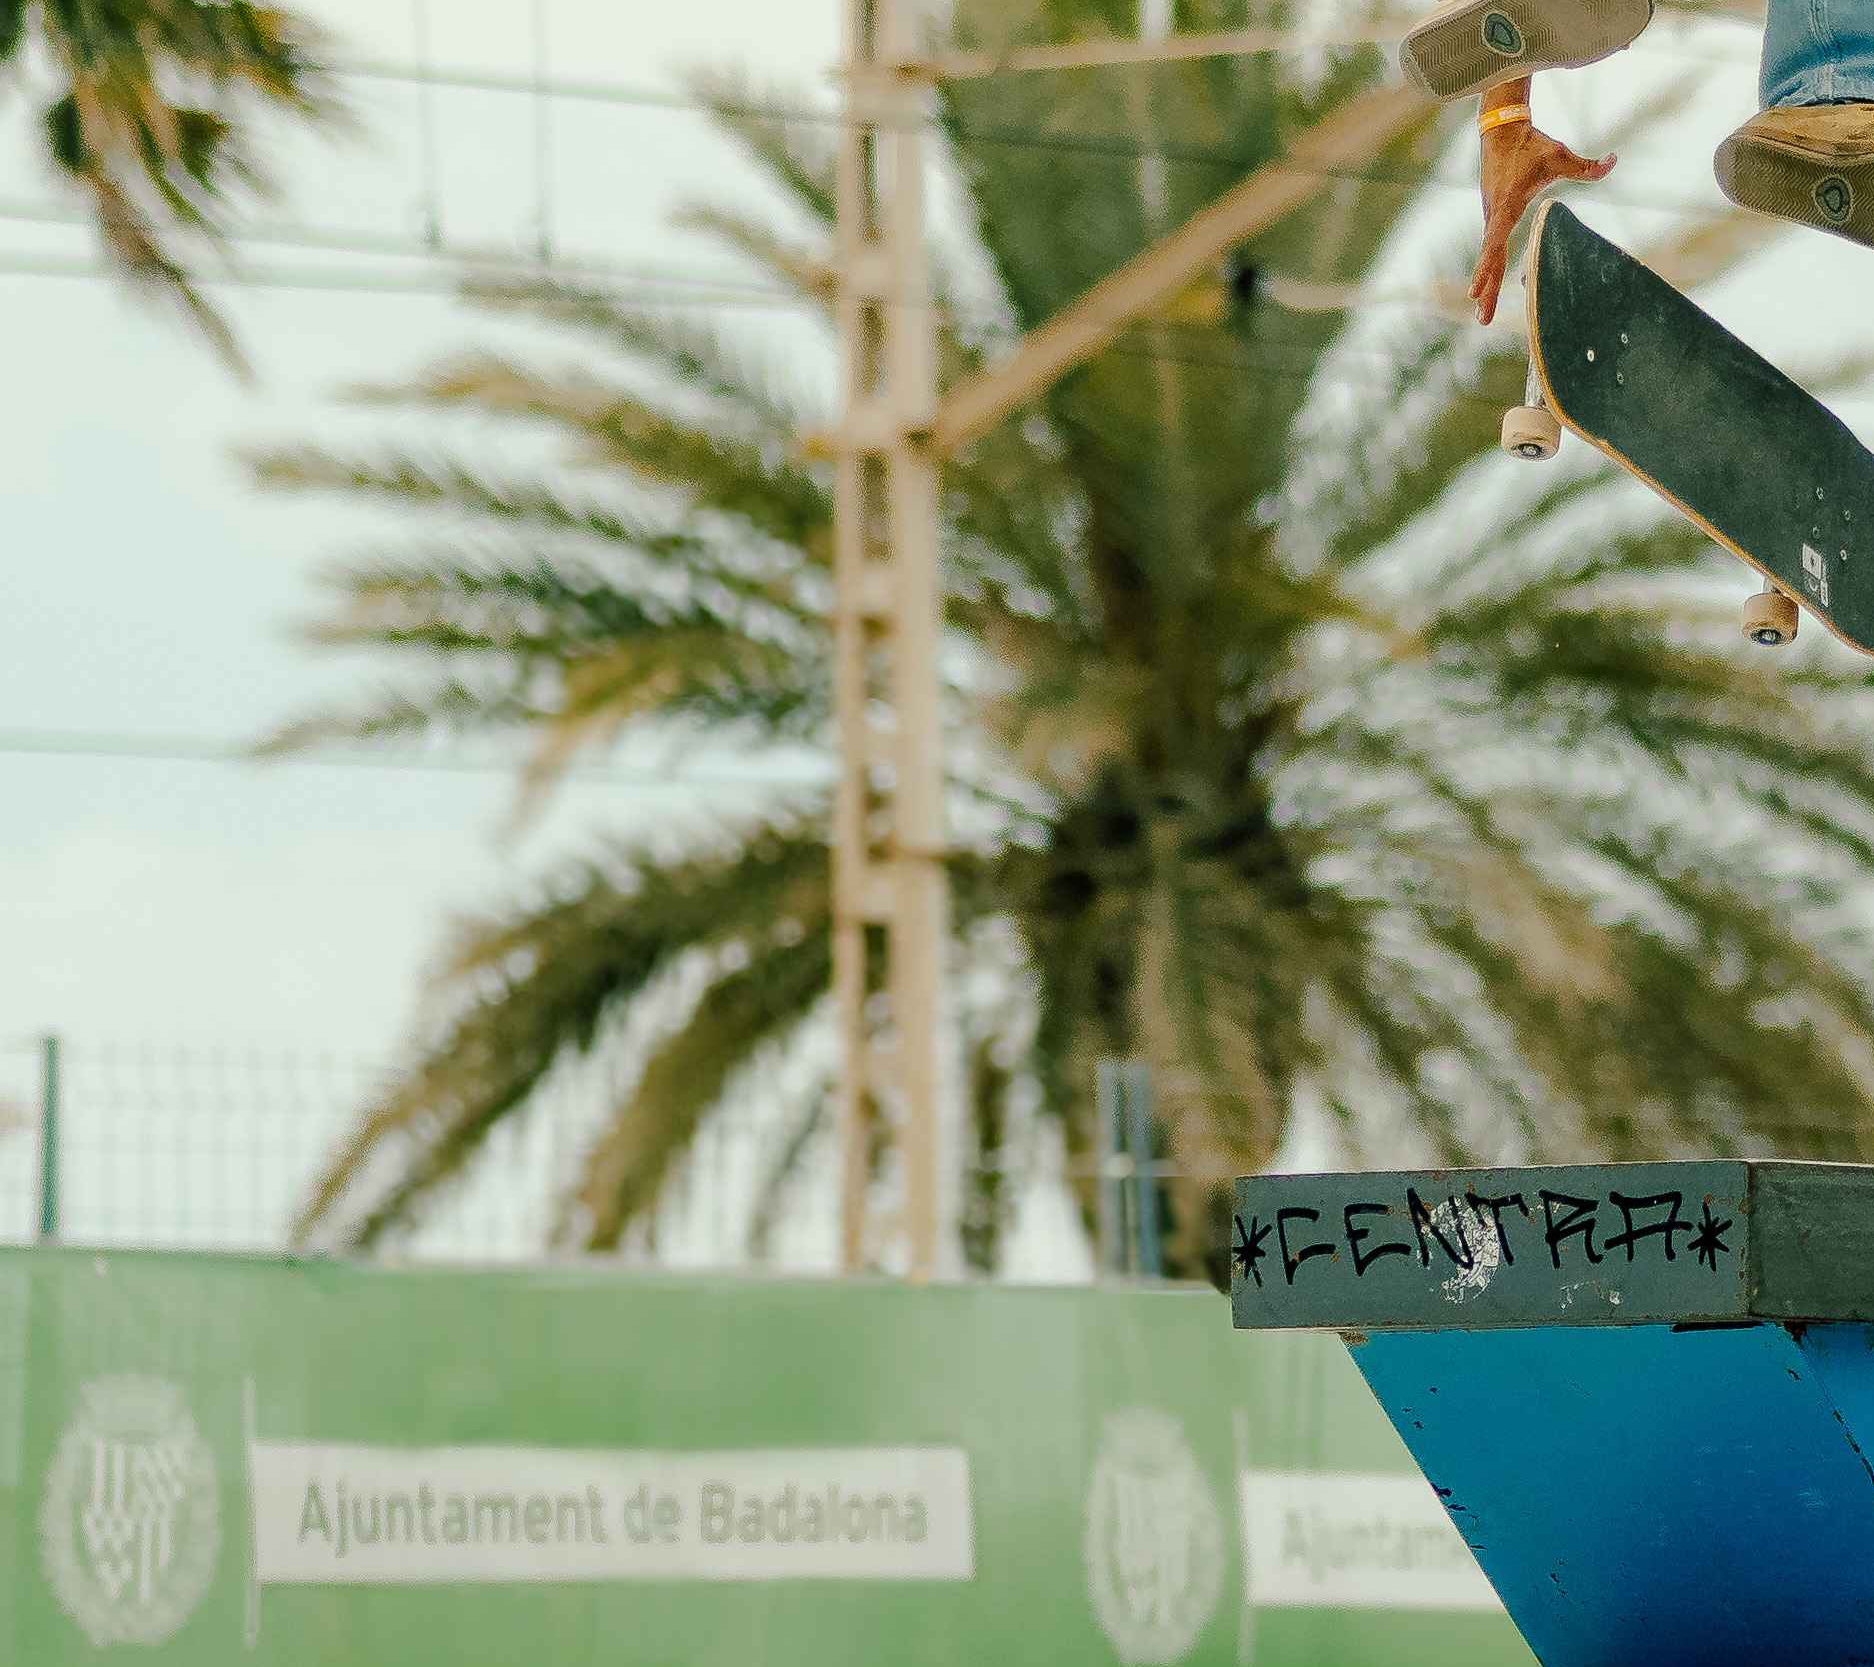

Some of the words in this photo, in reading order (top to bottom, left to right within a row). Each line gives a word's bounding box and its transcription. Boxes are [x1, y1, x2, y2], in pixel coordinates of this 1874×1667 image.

[301, 1478, 608, 1558] Ajuntament
[624, 1480, 682, 1543] de
[699, 1479, 930, 1544] Badalona
